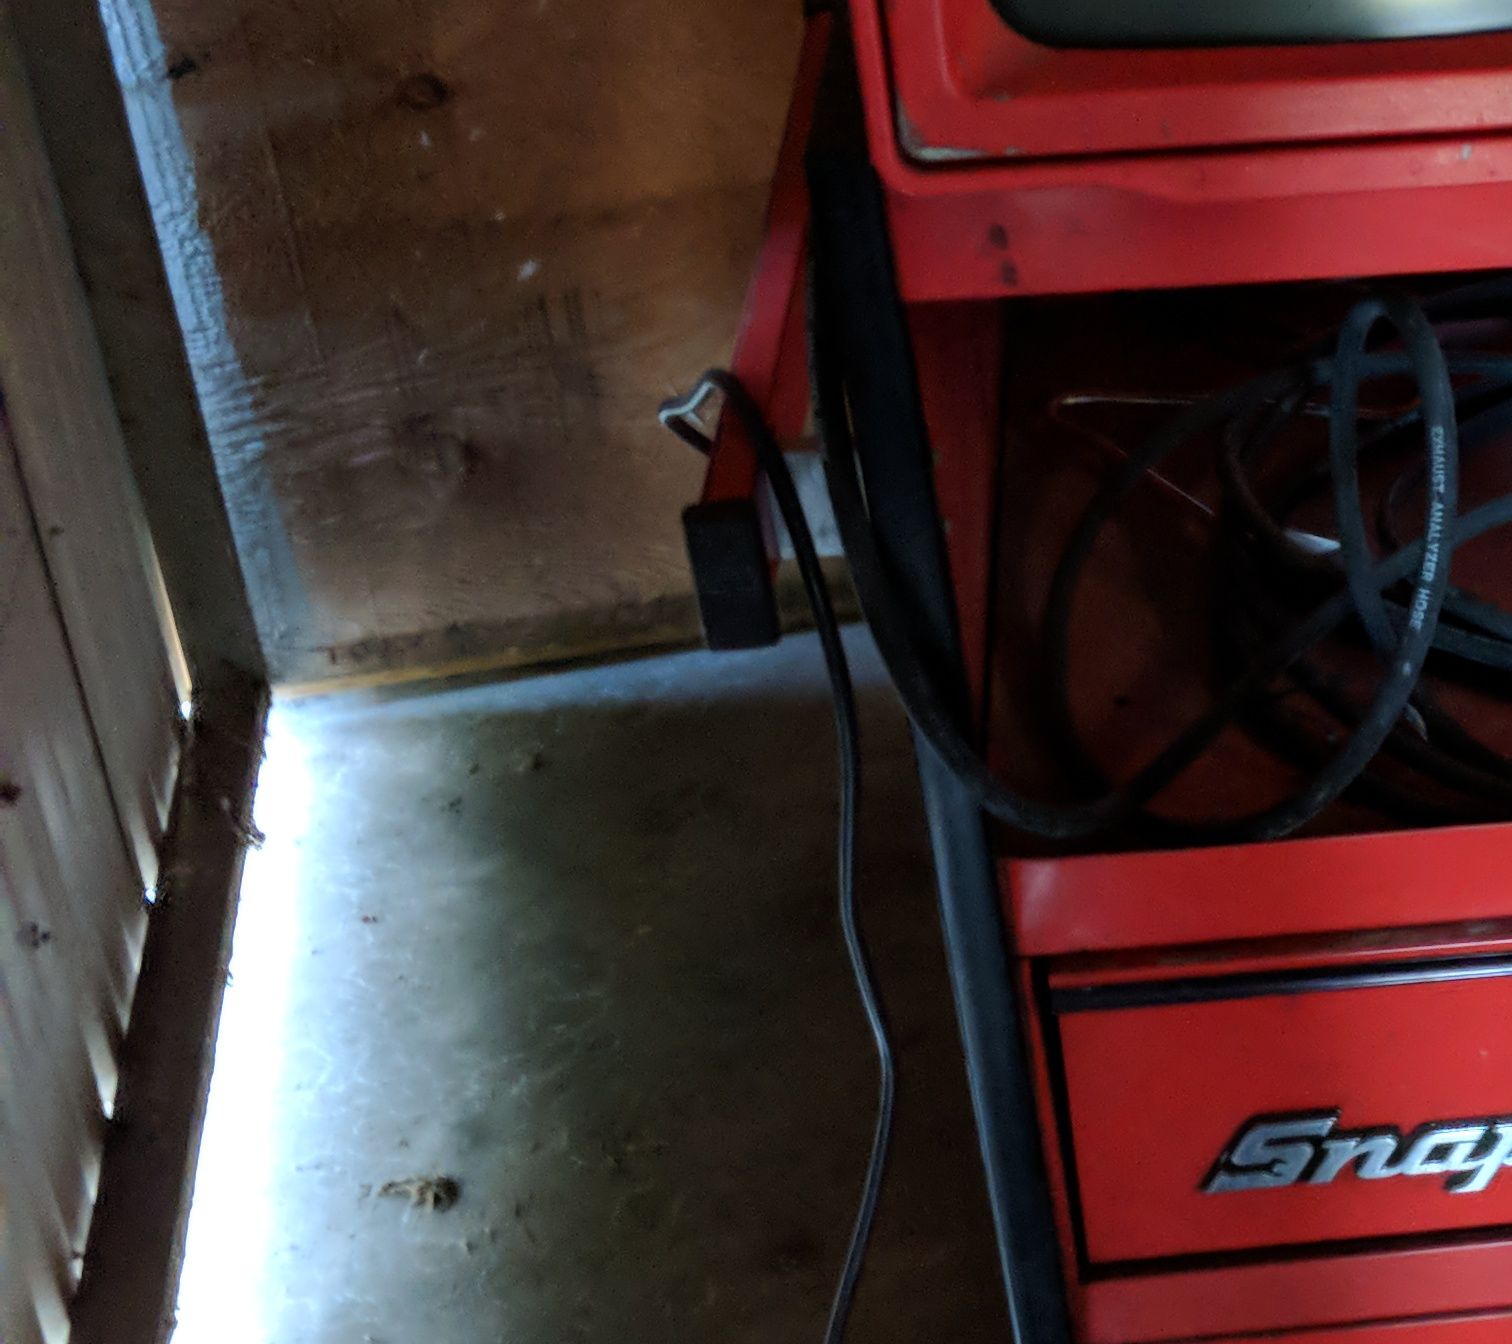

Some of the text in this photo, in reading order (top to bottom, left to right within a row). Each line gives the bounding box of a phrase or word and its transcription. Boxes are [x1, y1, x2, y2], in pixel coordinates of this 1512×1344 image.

[1410, 425, 1445, 632] EXHAUST ANALYZER HOSE
